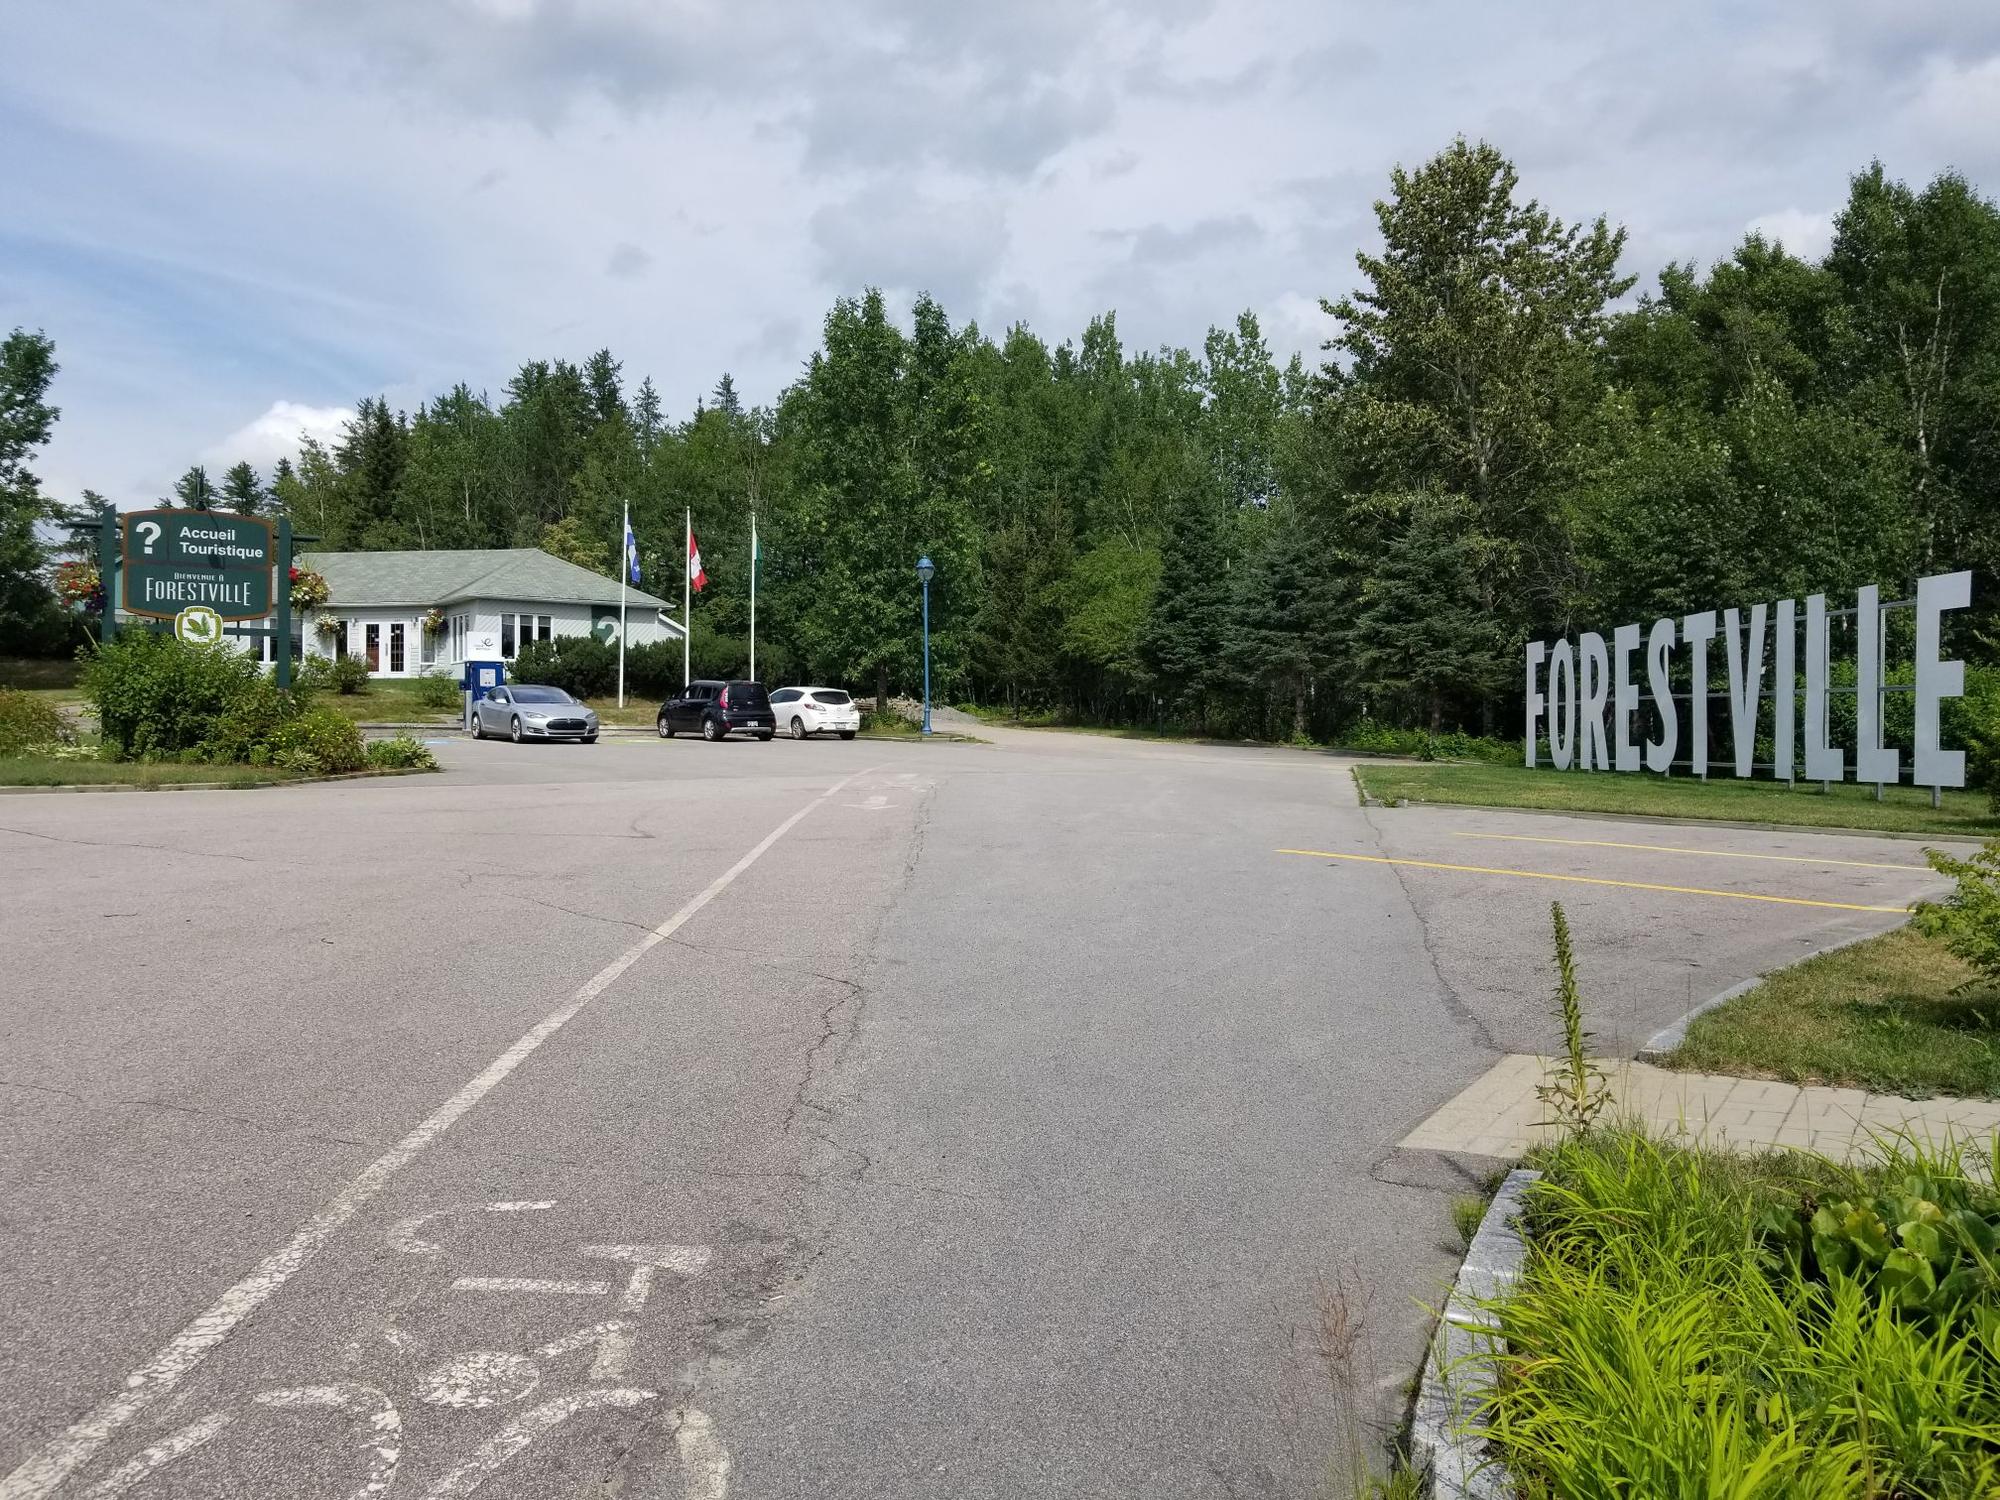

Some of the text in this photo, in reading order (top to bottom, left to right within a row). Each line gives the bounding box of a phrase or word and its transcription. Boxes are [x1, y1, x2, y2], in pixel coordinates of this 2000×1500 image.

[179, 526, 236, 541] Accueil
[179, 541, 264, 559] Touristique
[174, 572, 216, 581] BIENVENUE
[146, 577, 251, 606] FORESTVILLE
[1526, 570, 1972, 787] FORESTVILLE
